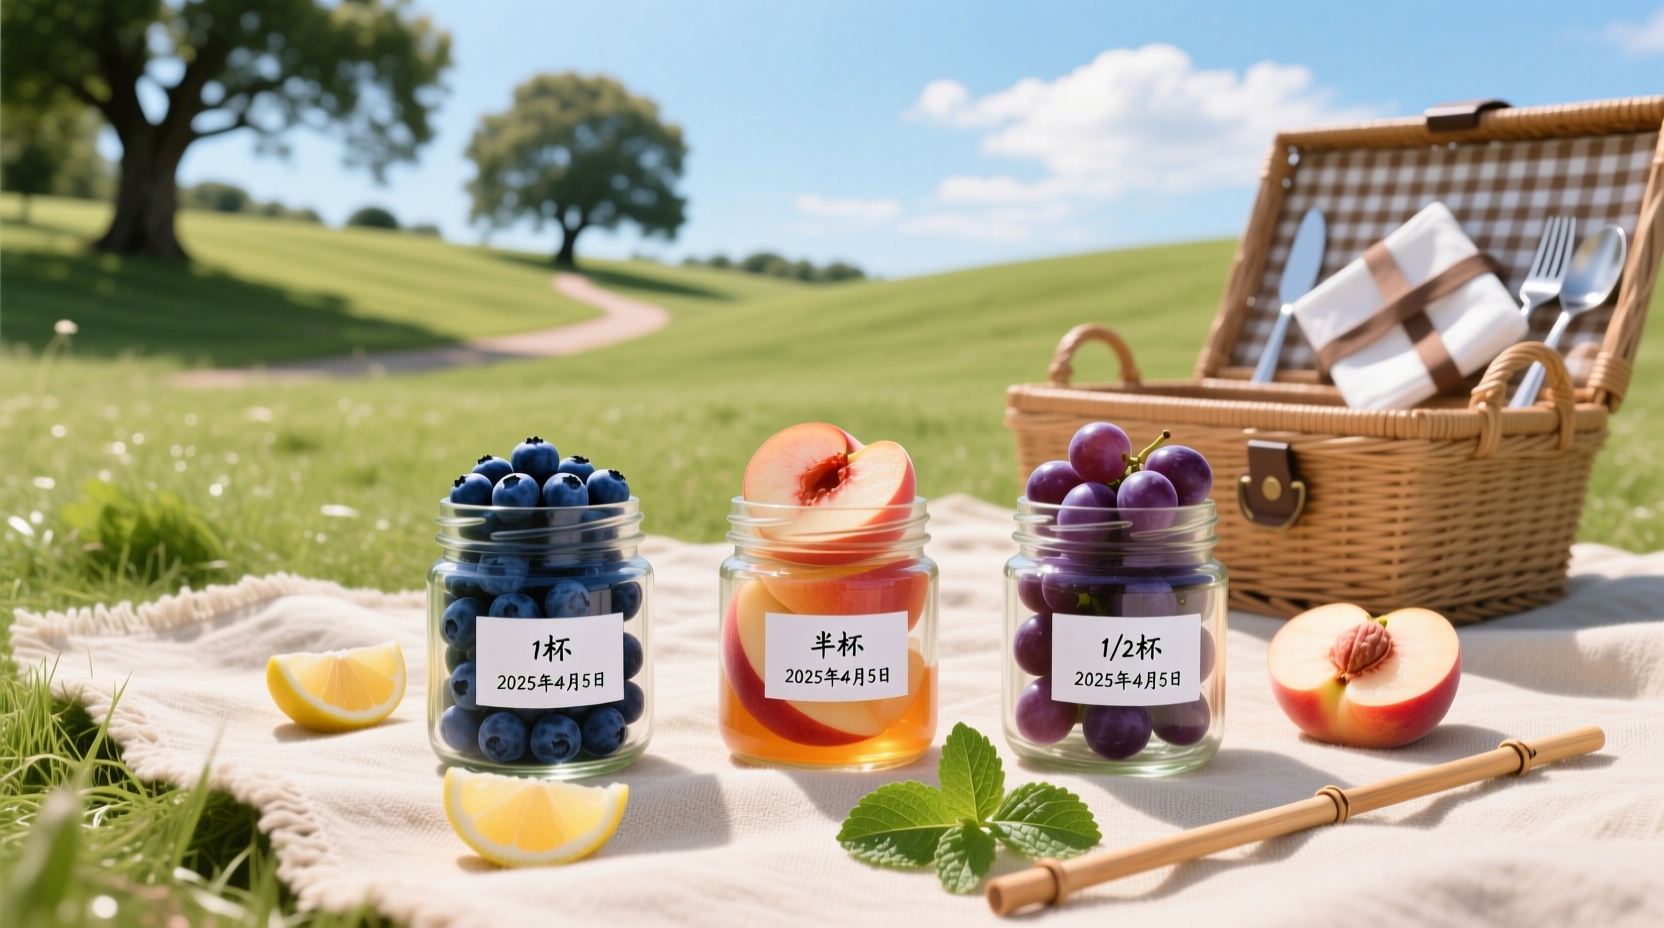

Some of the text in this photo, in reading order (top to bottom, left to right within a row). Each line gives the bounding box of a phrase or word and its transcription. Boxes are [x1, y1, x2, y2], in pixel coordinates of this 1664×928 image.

[532, 634, 572, 663] 1杯
[810, 630, 864, 660] 半杯
[1101, 633, 1162, 662] 1/2杯
[496, 671, 604, 693] 2025年4月5日
[784, 666, 890, 688] 2025年4月5日
[1074, 670, 1181, 691] 2025年4月5日
